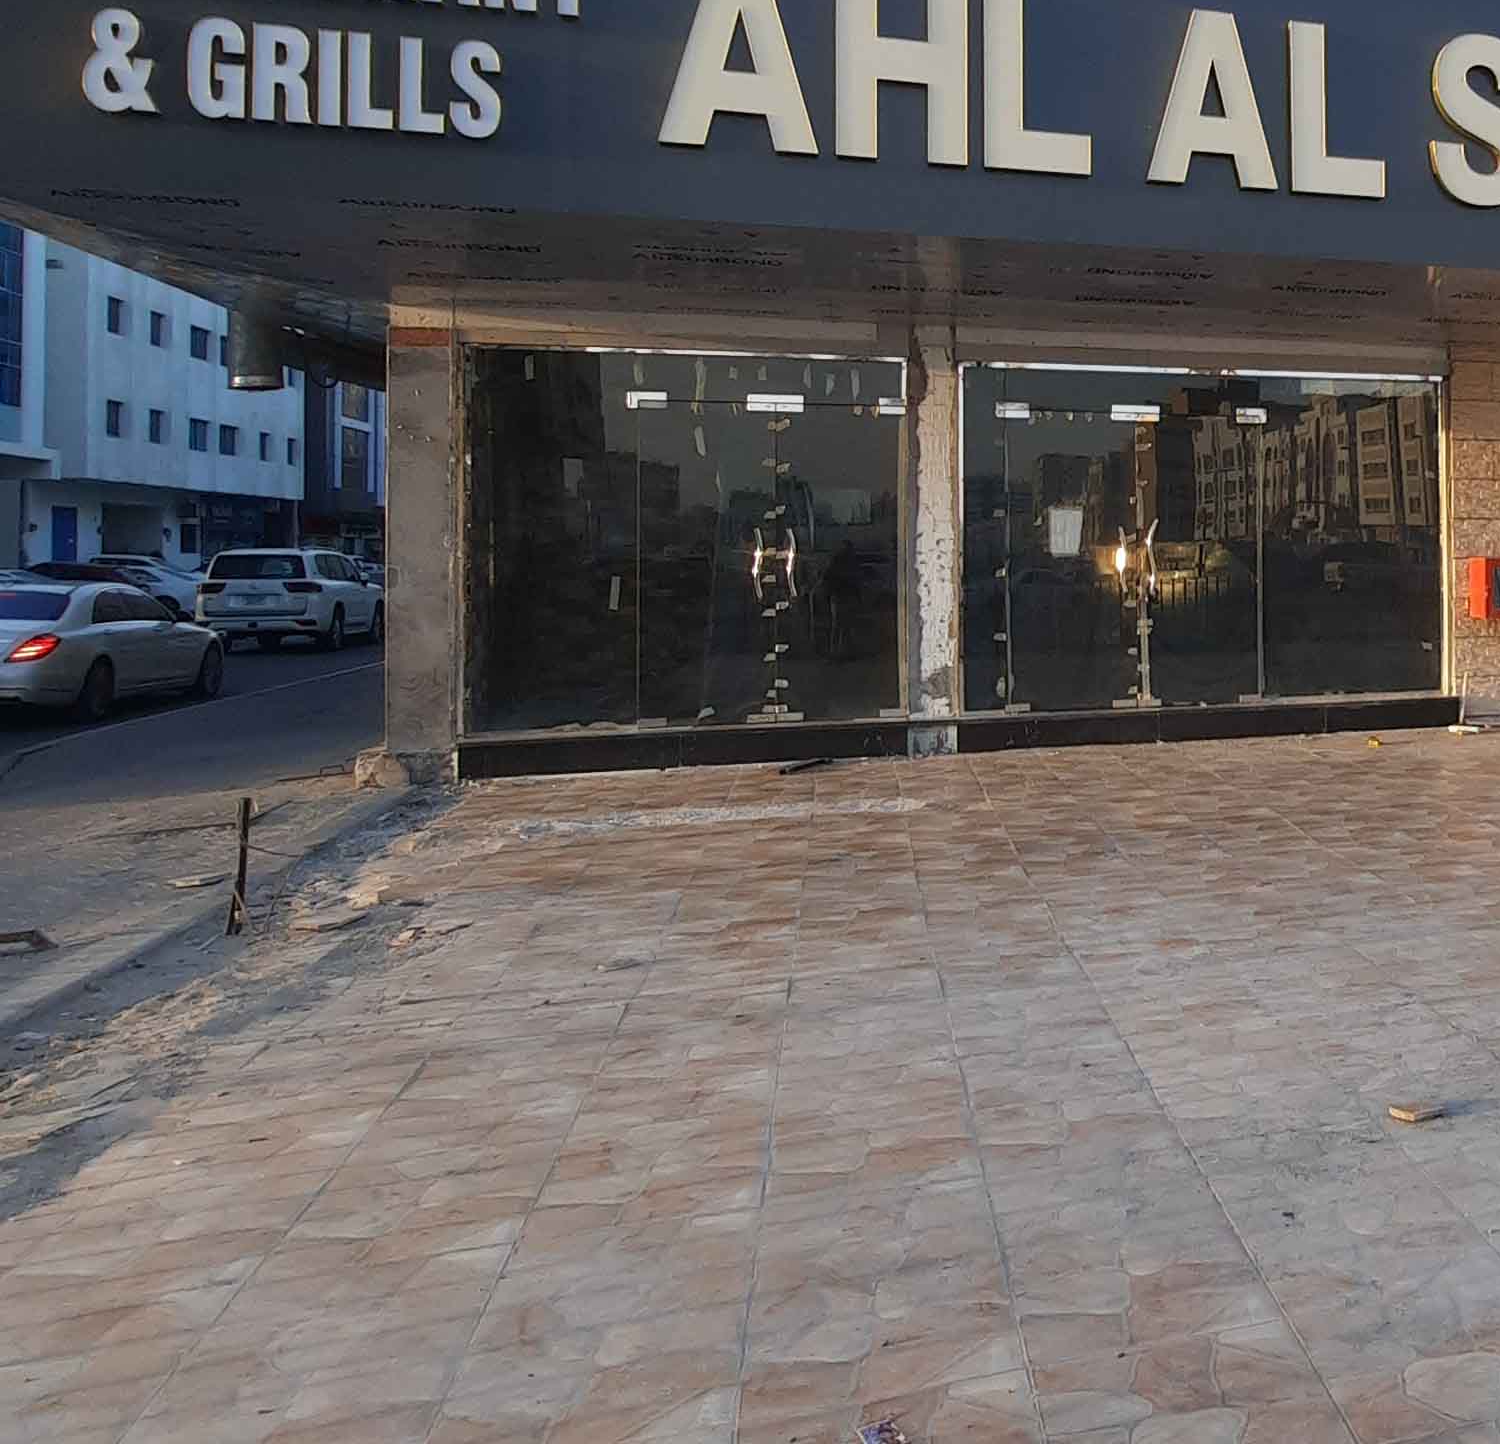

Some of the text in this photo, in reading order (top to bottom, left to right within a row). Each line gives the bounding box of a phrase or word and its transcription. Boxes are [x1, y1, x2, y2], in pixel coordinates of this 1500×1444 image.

[82, 8, 501, 138] & GRILLS
[1146, 9, 1386, 198] AL
